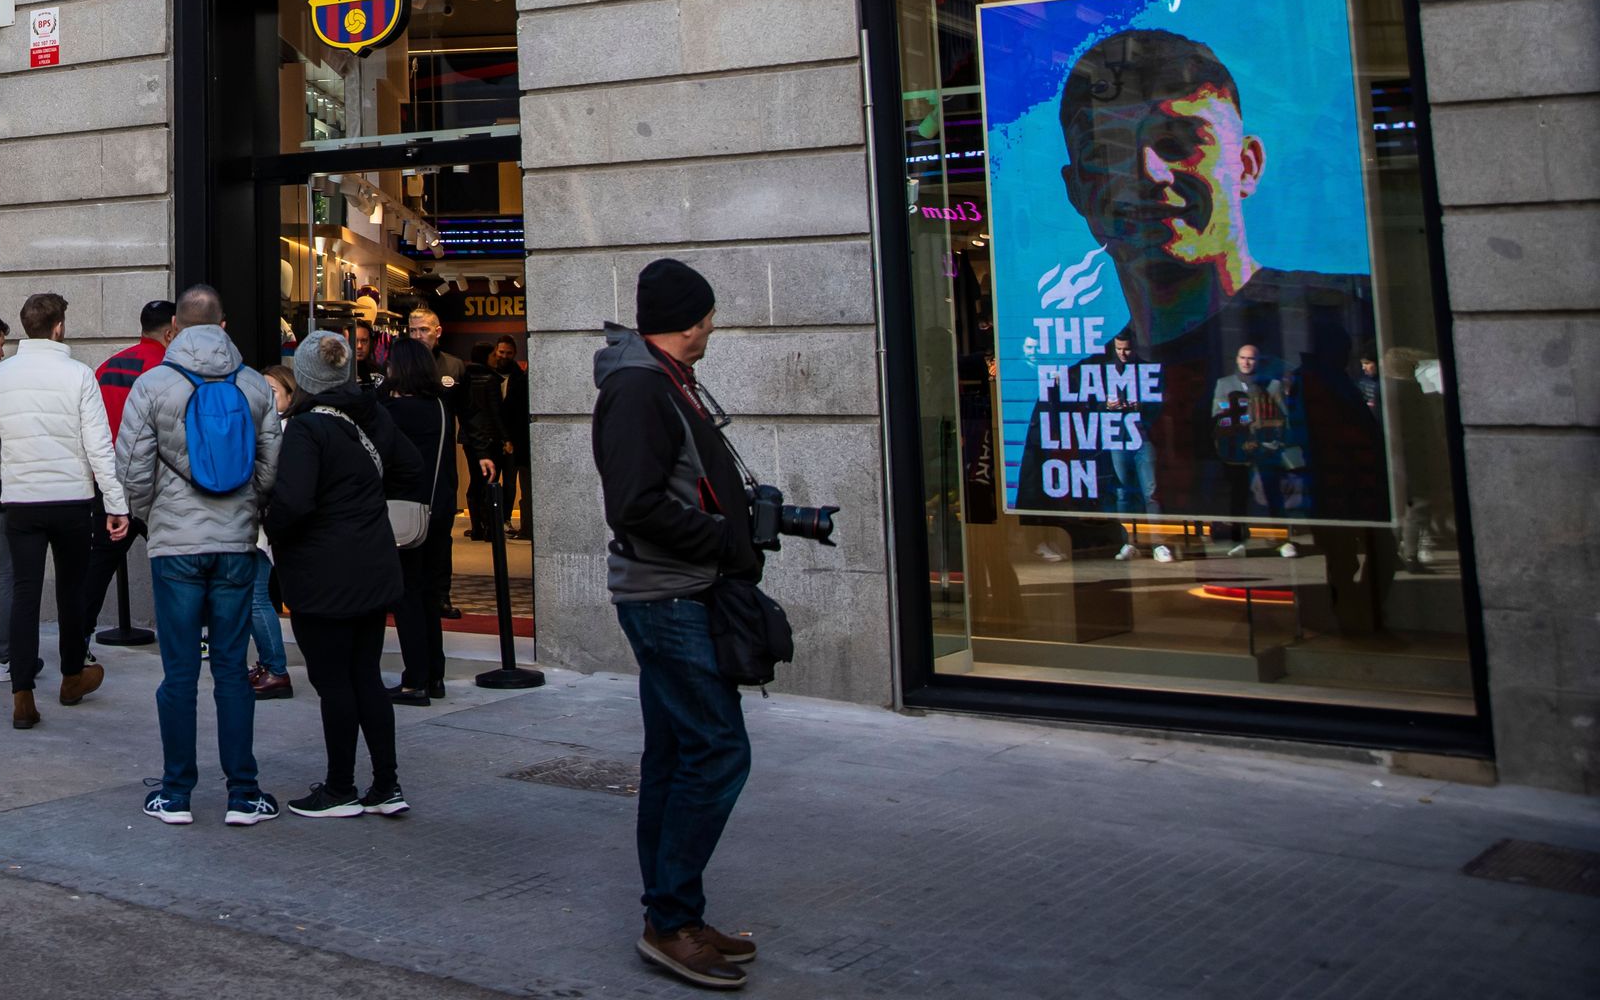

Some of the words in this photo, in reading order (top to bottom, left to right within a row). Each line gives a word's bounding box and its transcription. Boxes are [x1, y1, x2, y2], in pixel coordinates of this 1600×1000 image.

[464, 295, 525, 316] STORE
[1032, 316, 1106, 355] THE
[1037, 363, 1163, 403] FLAME
[1039, 411, 1144, 451] LIVES
[1041, 458, 1098, 499] ON
